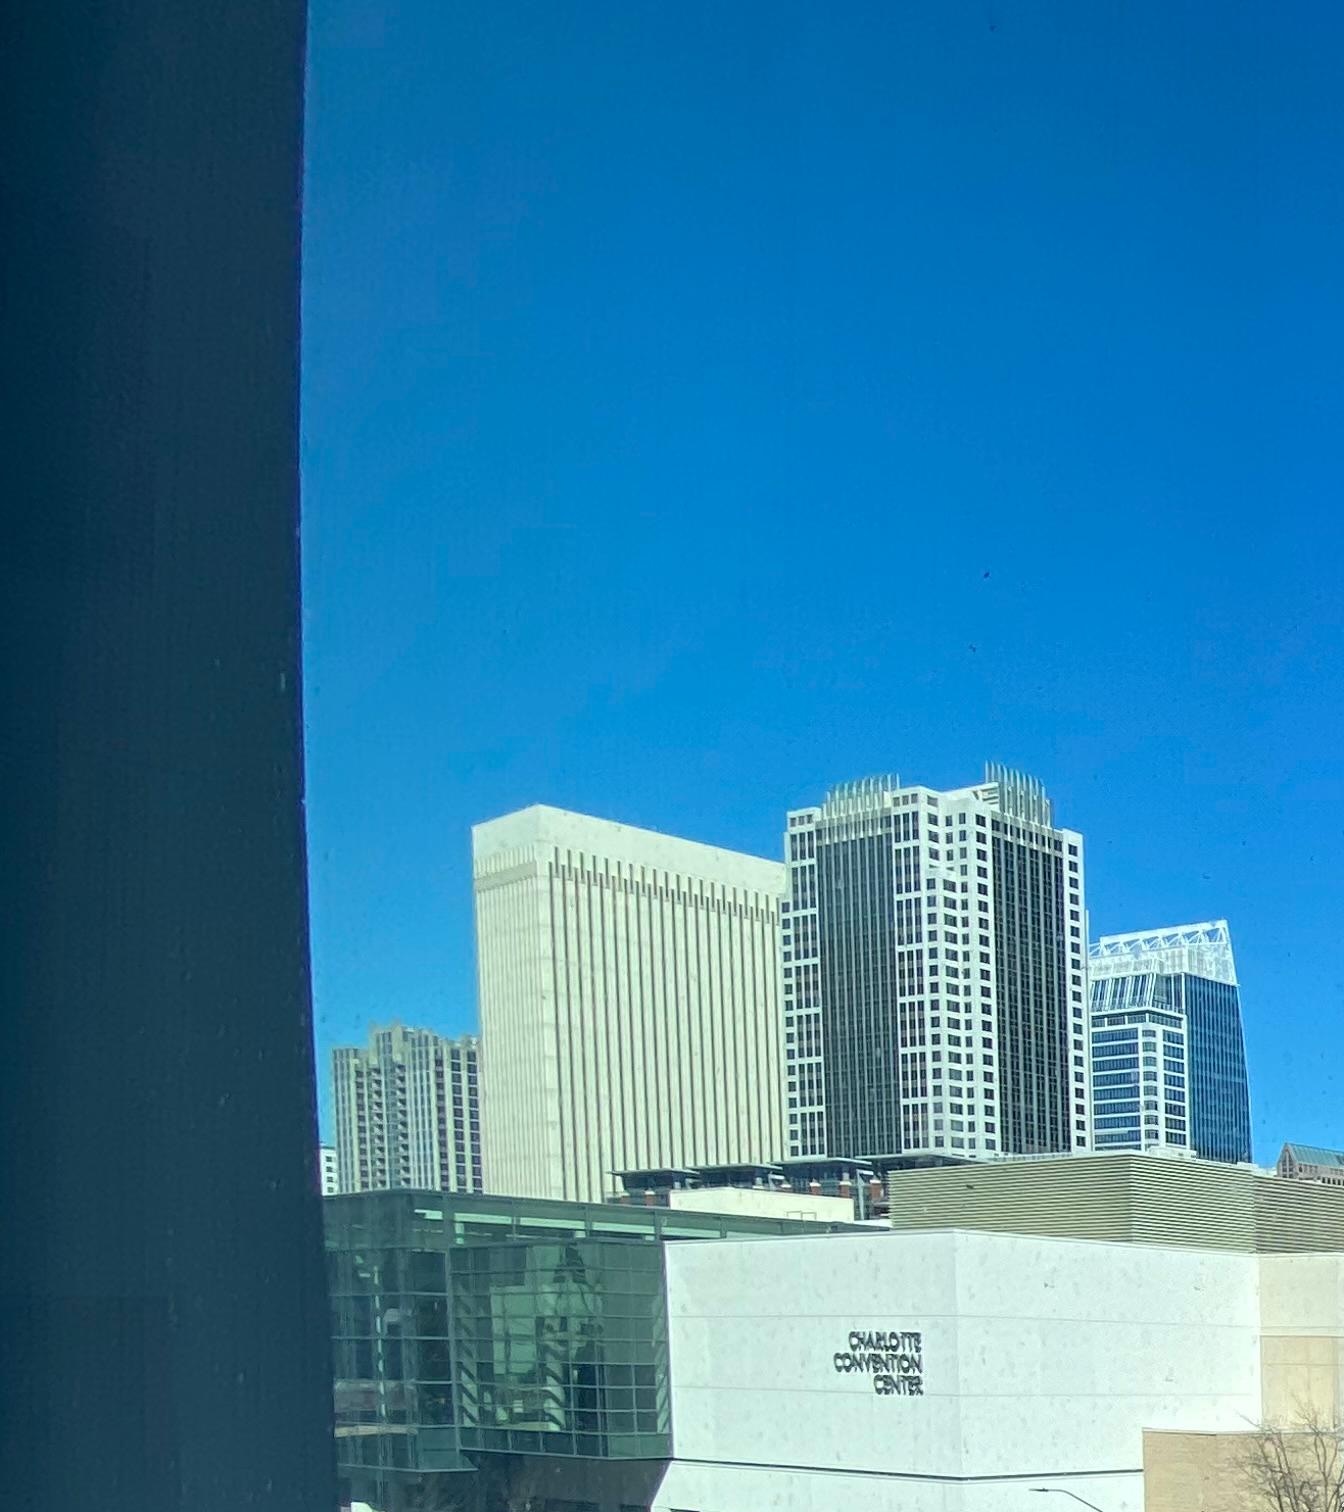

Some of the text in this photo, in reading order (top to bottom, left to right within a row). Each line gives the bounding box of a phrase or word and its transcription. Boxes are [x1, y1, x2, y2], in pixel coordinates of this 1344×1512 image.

[848, 1331, 921, 1353] CHARLOTTE
[833, 1352, 922, 1373] CONVENTION
[873, 1374, 923, 1395] CENTER
